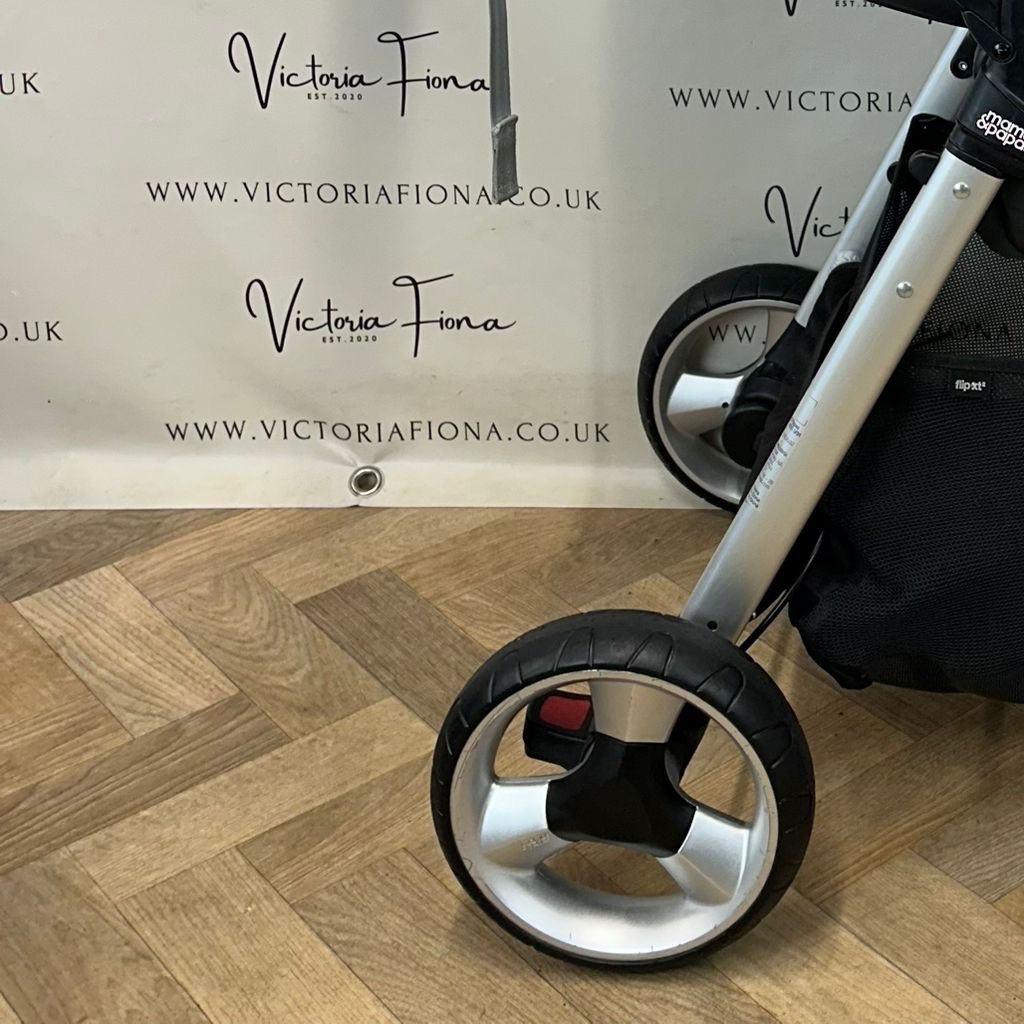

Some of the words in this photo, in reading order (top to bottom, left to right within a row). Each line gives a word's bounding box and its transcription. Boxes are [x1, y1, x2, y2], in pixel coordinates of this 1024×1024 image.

[228, 31, 382, 110] Victoria
[378, 31, 490, 117] Fiona
[306, 92, 363, 101] EST.2020
[245, 278, 399, 354] Victoria
[393, 274, 517, 358] Fiona
[321, 334, 378, 344] EST.2020
[165, 419, 610, 444] WWW.VICTORIAFIONA.CO.UK
